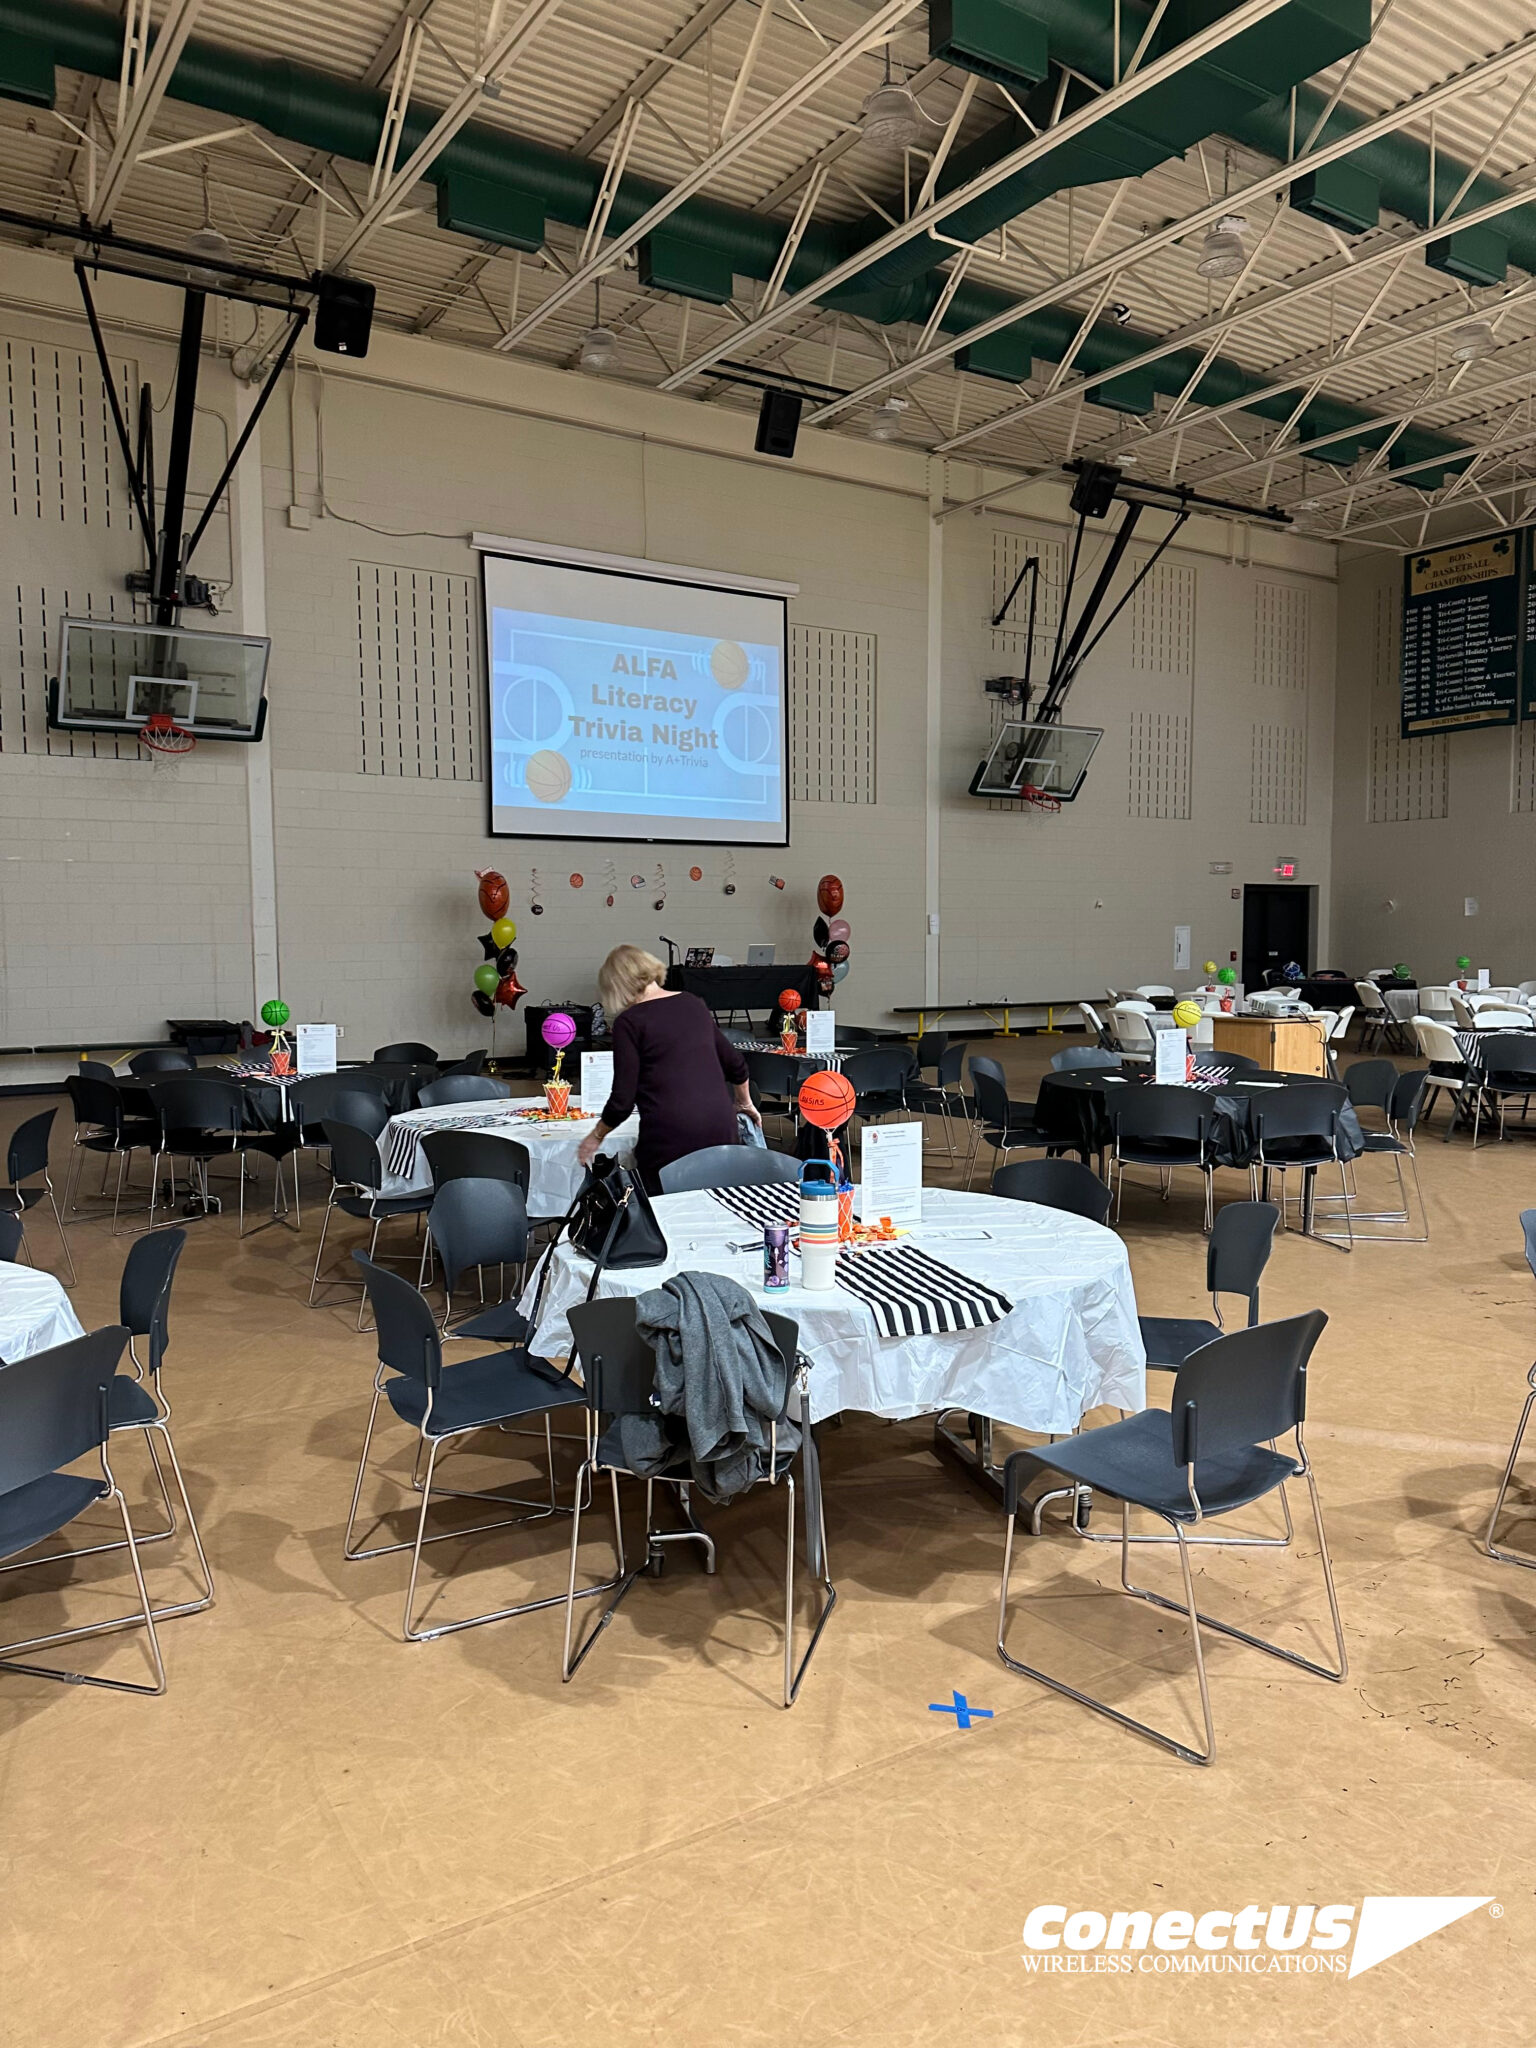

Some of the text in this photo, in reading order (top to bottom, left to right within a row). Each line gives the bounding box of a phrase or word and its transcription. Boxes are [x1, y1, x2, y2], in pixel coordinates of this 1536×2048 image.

[1449, 552, 1472, 563] BOYS
[1425, 569, 1499, 590] CHAMPIONSHIPS
[1433, 560, 1490, 578] BASKETBALL
[611, 653, 678, 680] ALFA
[591, 684, 698, 719] Literacy
[568, 715, 719, 752] Trivia Night
[580, 748, 709, 768] presentation by A+Trivia
